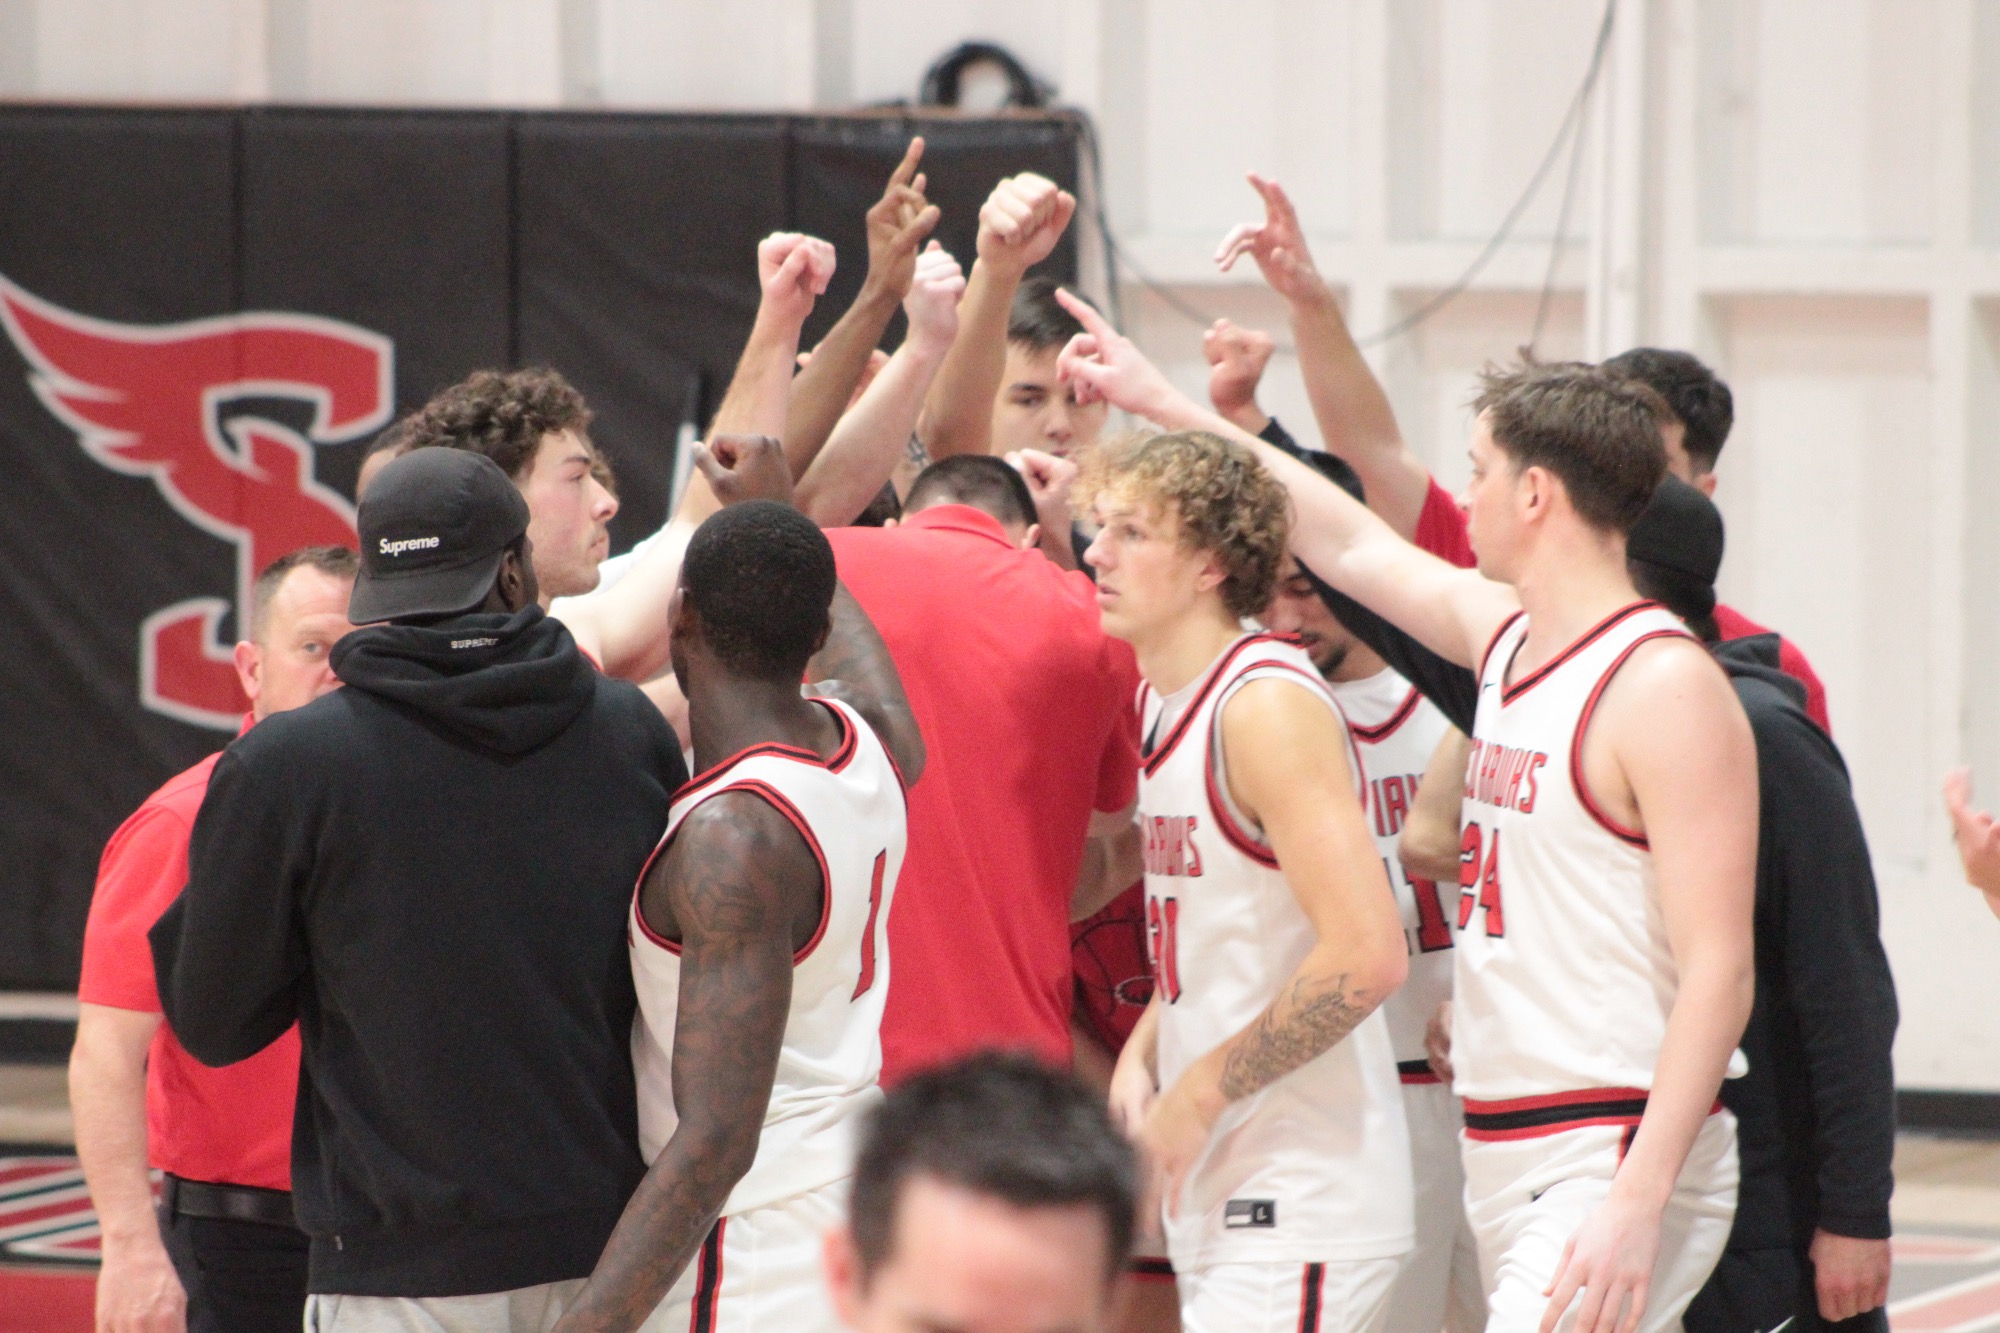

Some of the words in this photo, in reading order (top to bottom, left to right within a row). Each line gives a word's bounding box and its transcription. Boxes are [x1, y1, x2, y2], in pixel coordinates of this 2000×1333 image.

[379, 536, 440, 557] Supreme
[850, 846, 887, 1004] 1
[1384, 856, 1455, 956] 1
